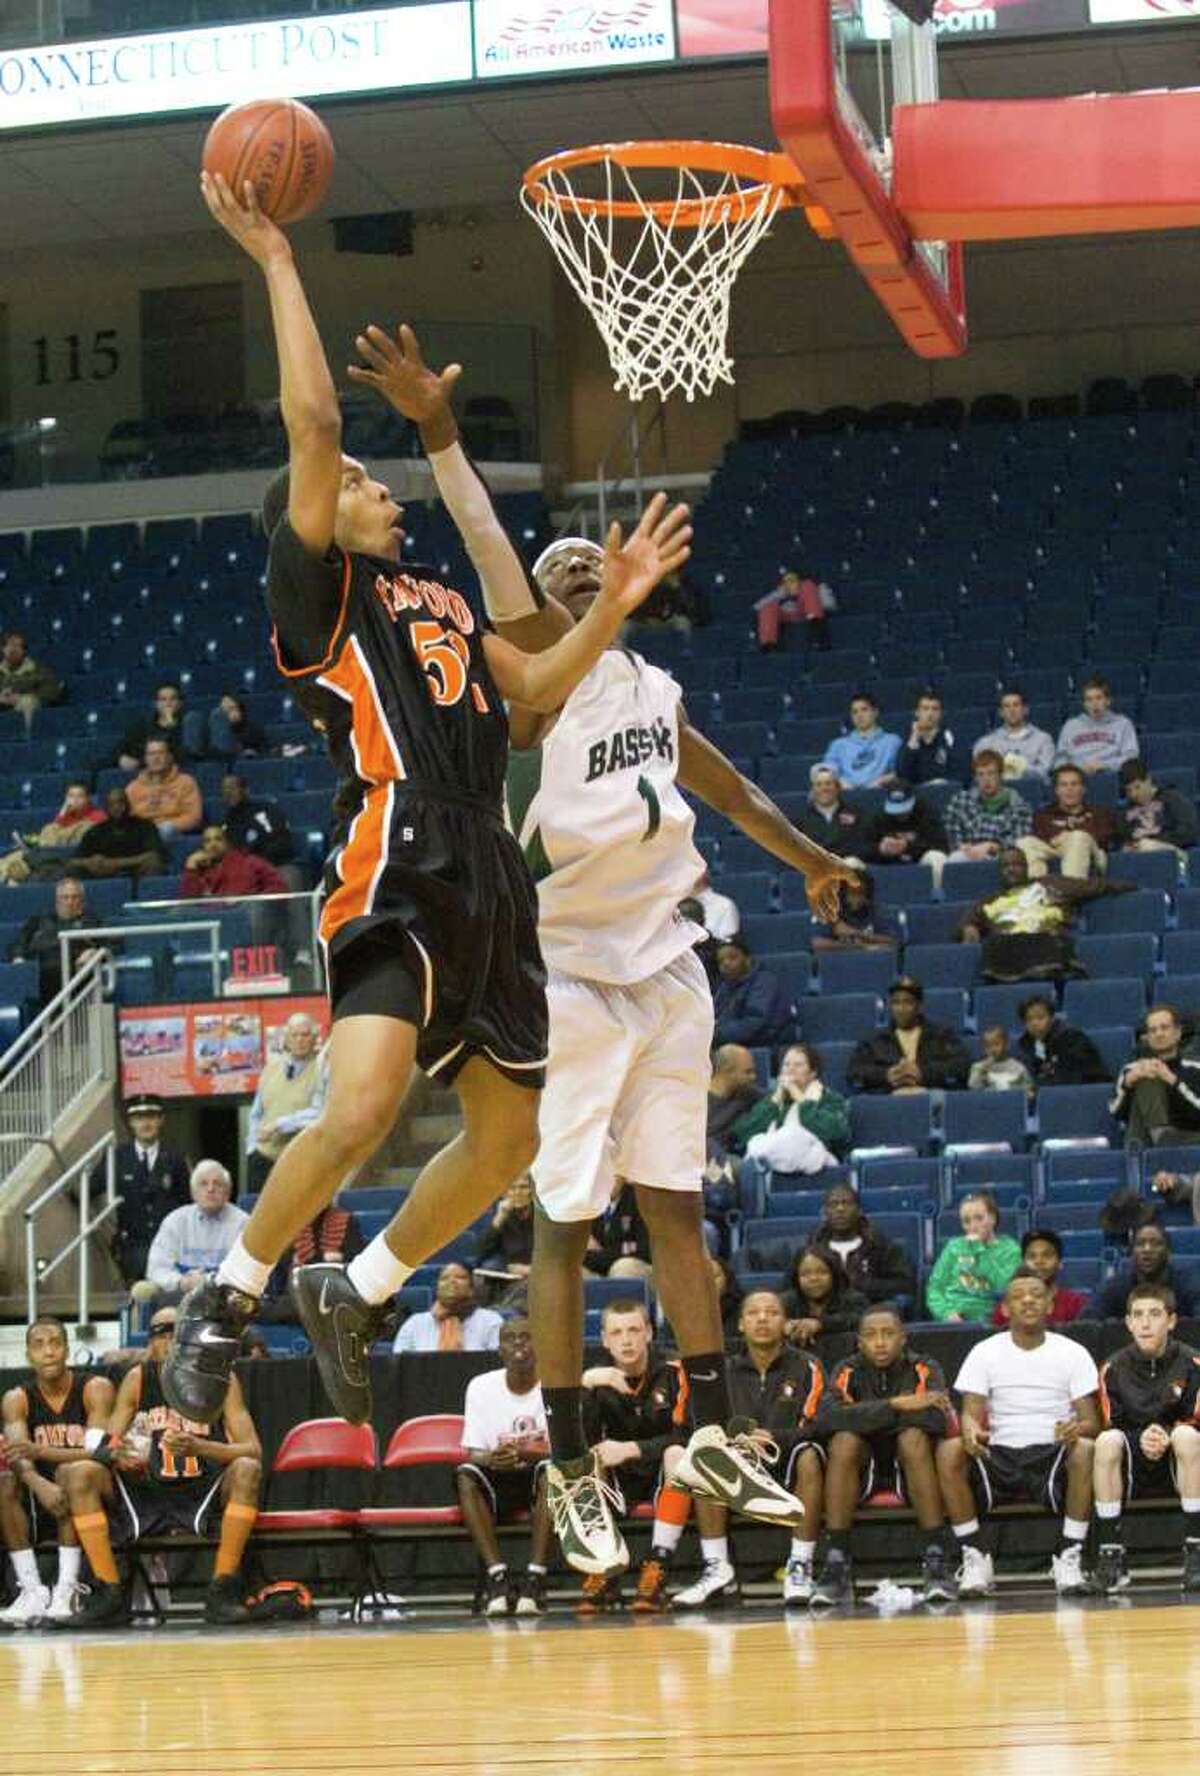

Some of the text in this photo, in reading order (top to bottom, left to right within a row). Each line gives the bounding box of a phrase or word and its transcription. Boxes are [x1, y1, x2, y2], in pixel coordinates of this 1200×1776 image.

[0, 19, 389, 95] ONNECTICUT POST
[516, 40, 602, 58] American
[607, 32, 665, 51] Waste
[32, 329, 121, 386] 115
[584, 715, 674, 783] BASSK
[637, 773, 661, 843] 1
[232, 944, 277, 979] EXIT
